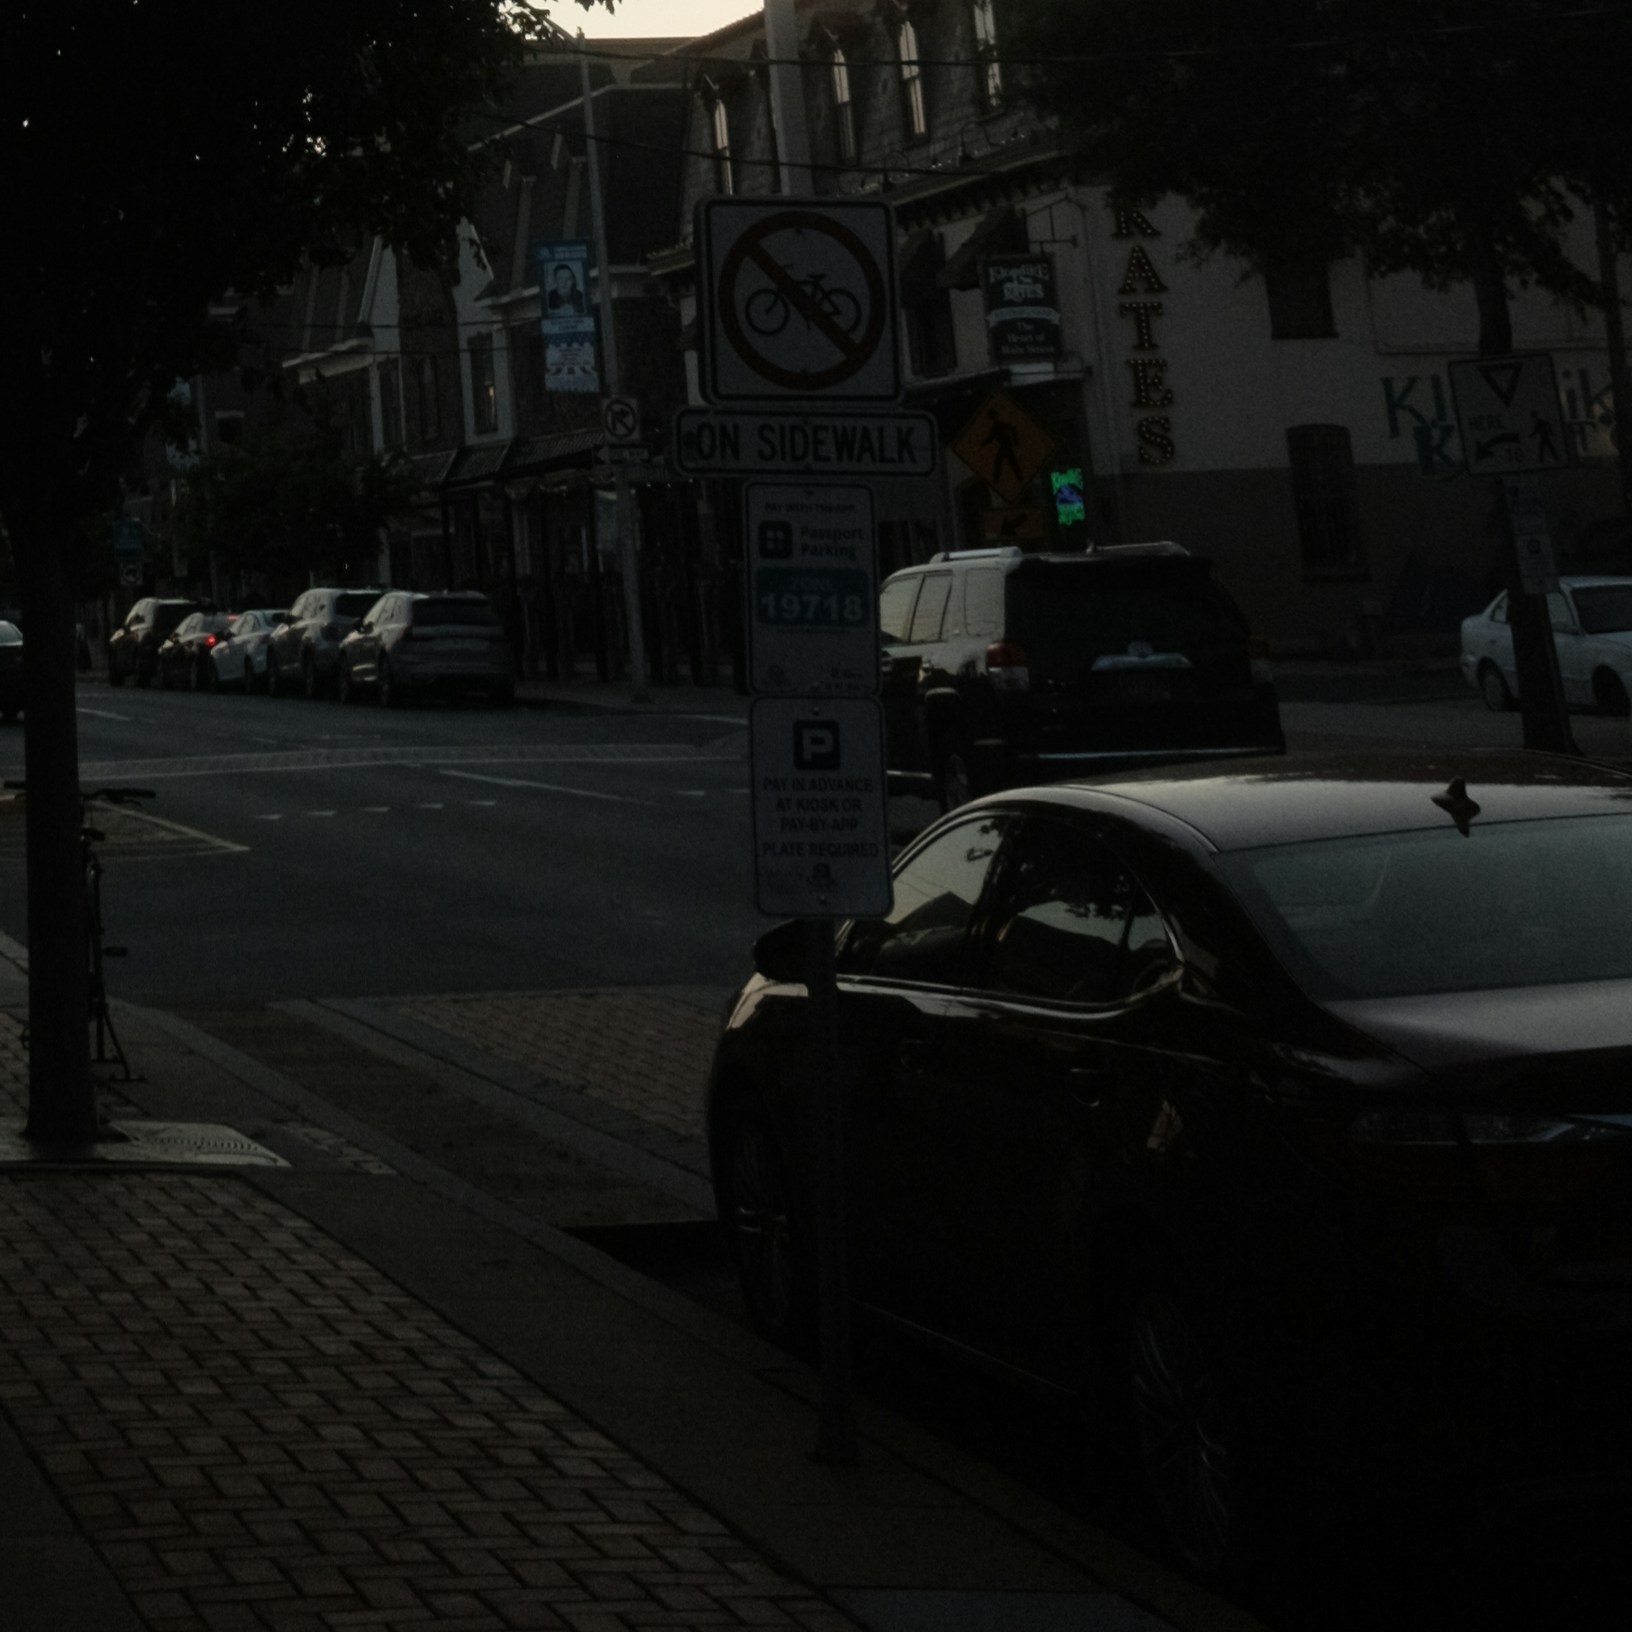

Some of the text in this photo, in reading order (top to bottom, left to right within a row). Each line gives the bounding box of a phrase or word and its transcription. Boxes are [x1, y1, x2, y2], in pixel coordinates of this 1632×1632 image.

[1467, 413, 1507, 431] HERE
[696, 422, 917, 464] ON SIDEWALK
[1505, 447, 1524, 464] TO
[800, 525, 865, 544] Passport
[801, 543, 857, 562] Parking
[761, 592, 863, 621] 19718
[762, 777, 874, 793] PAY IN ADVANCE
[775, 797, 863, 813] AT KIOSK OR
[780, 817, 859, 833] PAY-BY-APP
[762, 842, 880, 859] PLATE REQUIRED
